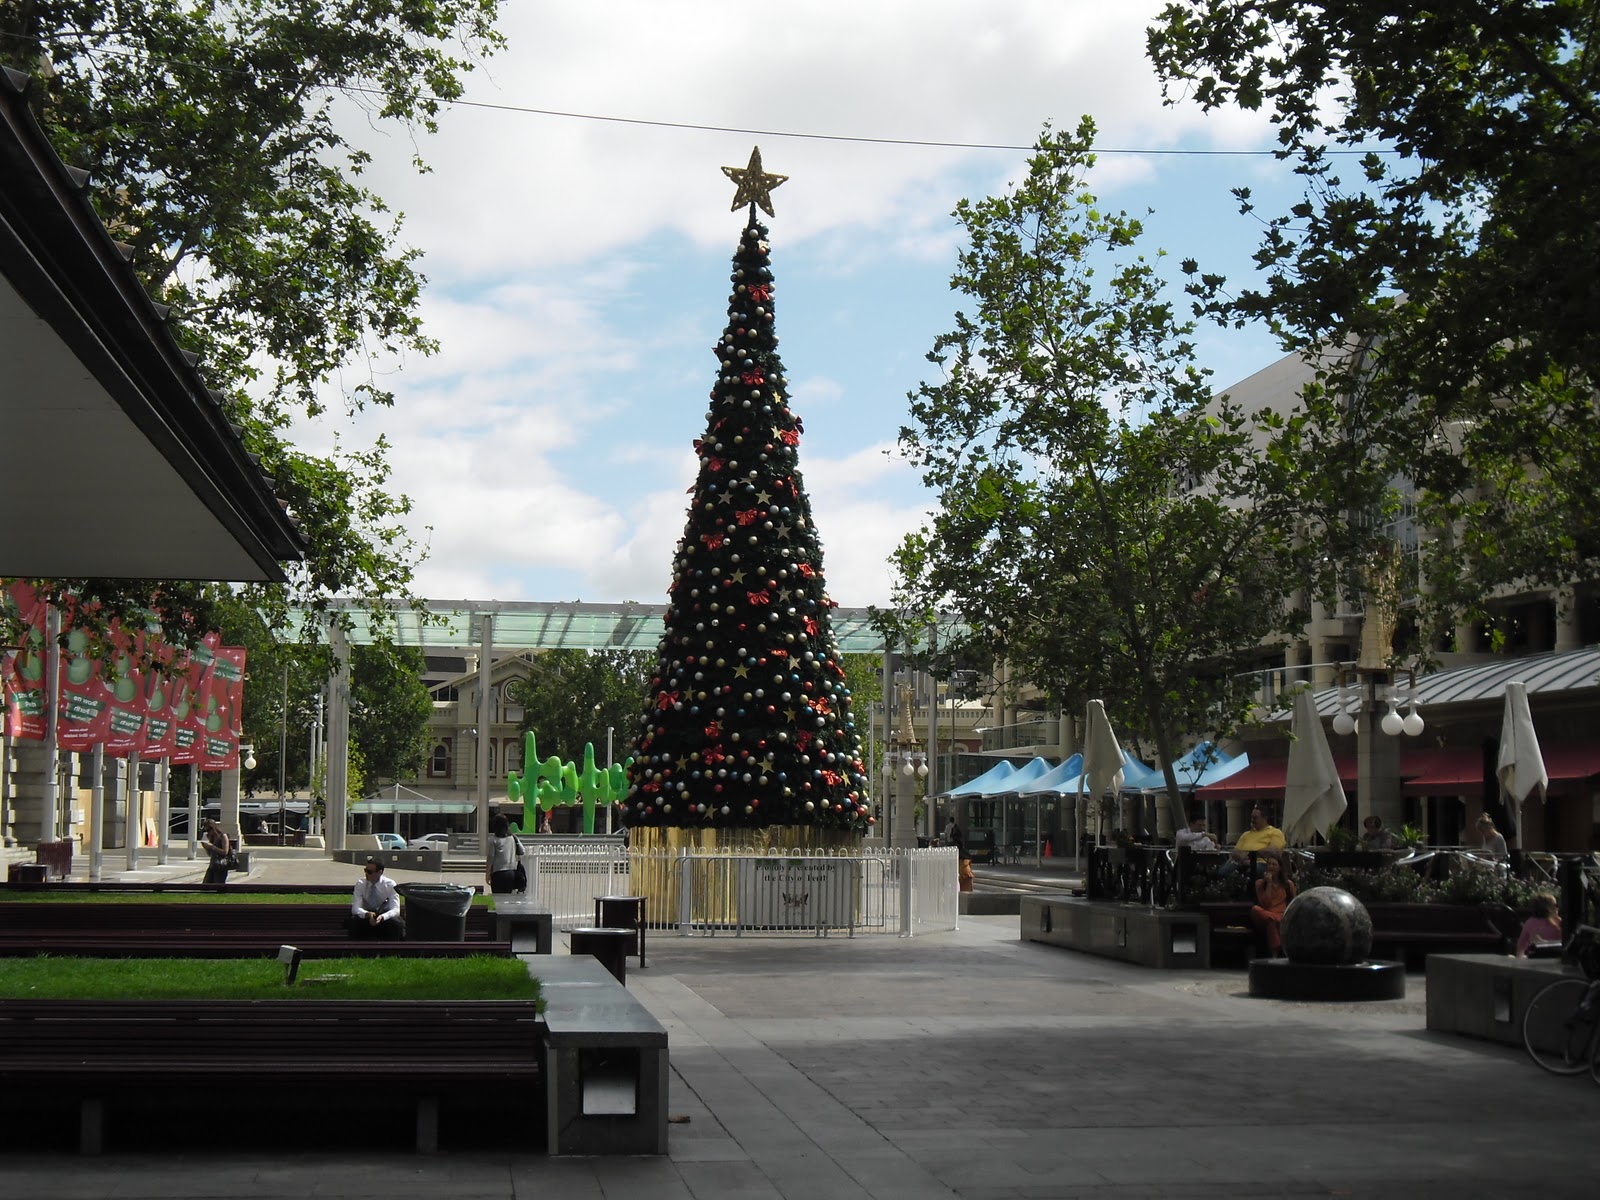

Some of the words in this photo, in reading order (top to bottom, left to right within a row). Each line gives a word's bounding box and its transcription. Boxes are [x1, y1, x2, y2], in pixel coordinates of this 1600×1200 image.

[756, 864, 785, 873] Poudly
[827, 864, 836, 873] by
[779, 875, 794, 884] City
